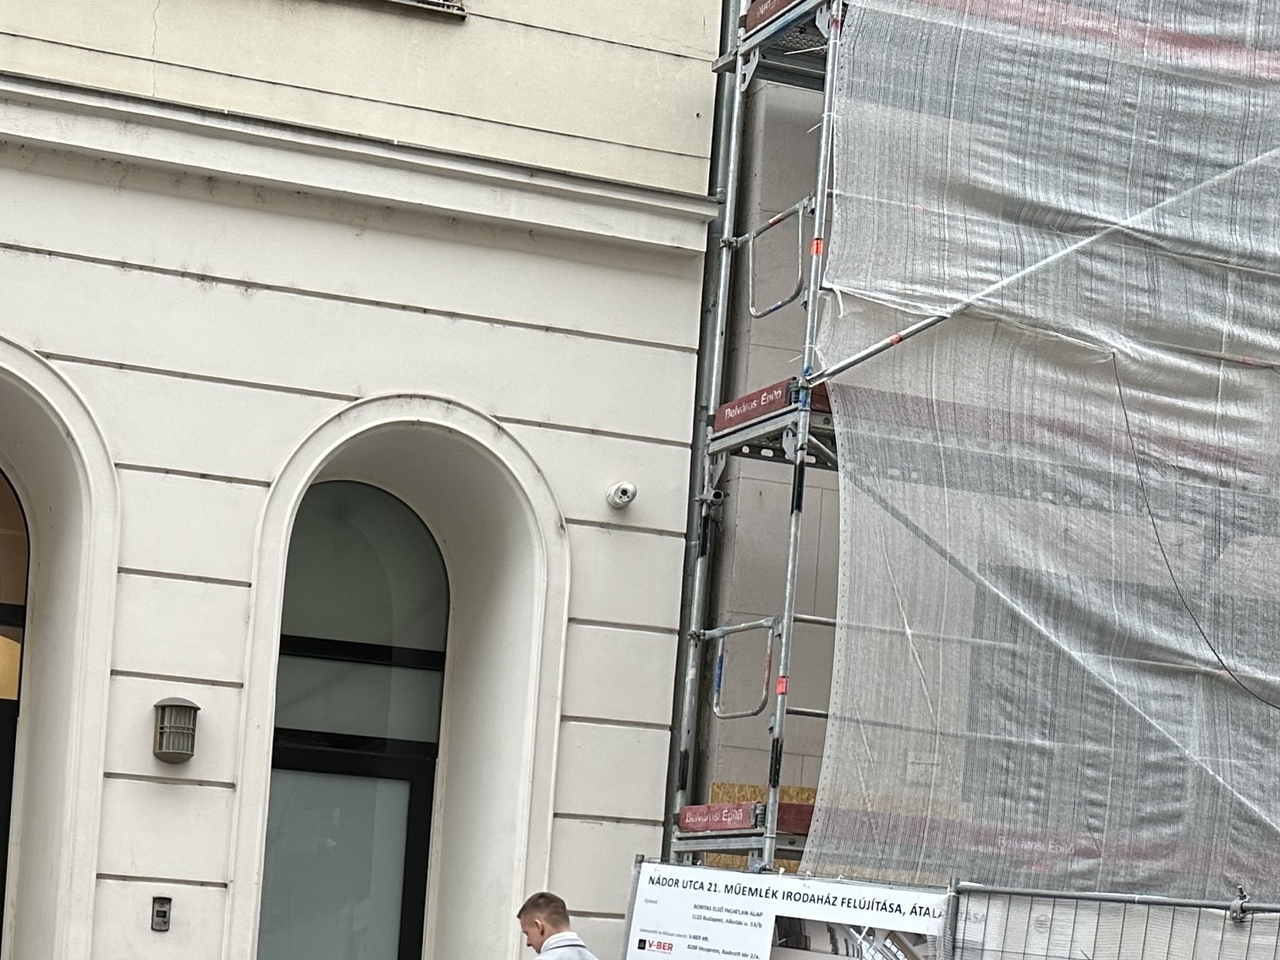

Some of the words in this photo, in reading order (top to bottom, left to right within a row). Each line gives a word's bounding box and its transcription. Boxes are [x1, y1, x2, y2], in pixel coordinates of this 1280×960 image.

[648, 875, 679, 889] NÁDOR
[682, 879, 704, 891] UTCA
[707, 882, 721, 894] 21.
[724, 882, 778, 900] MŰEMLÉK
[782, 891, 837, 907] IRODAHÁZ
[841, 897, 906, 916] FELÚJÍTÁSA,
[648, 940, 673, 952] V-BER
